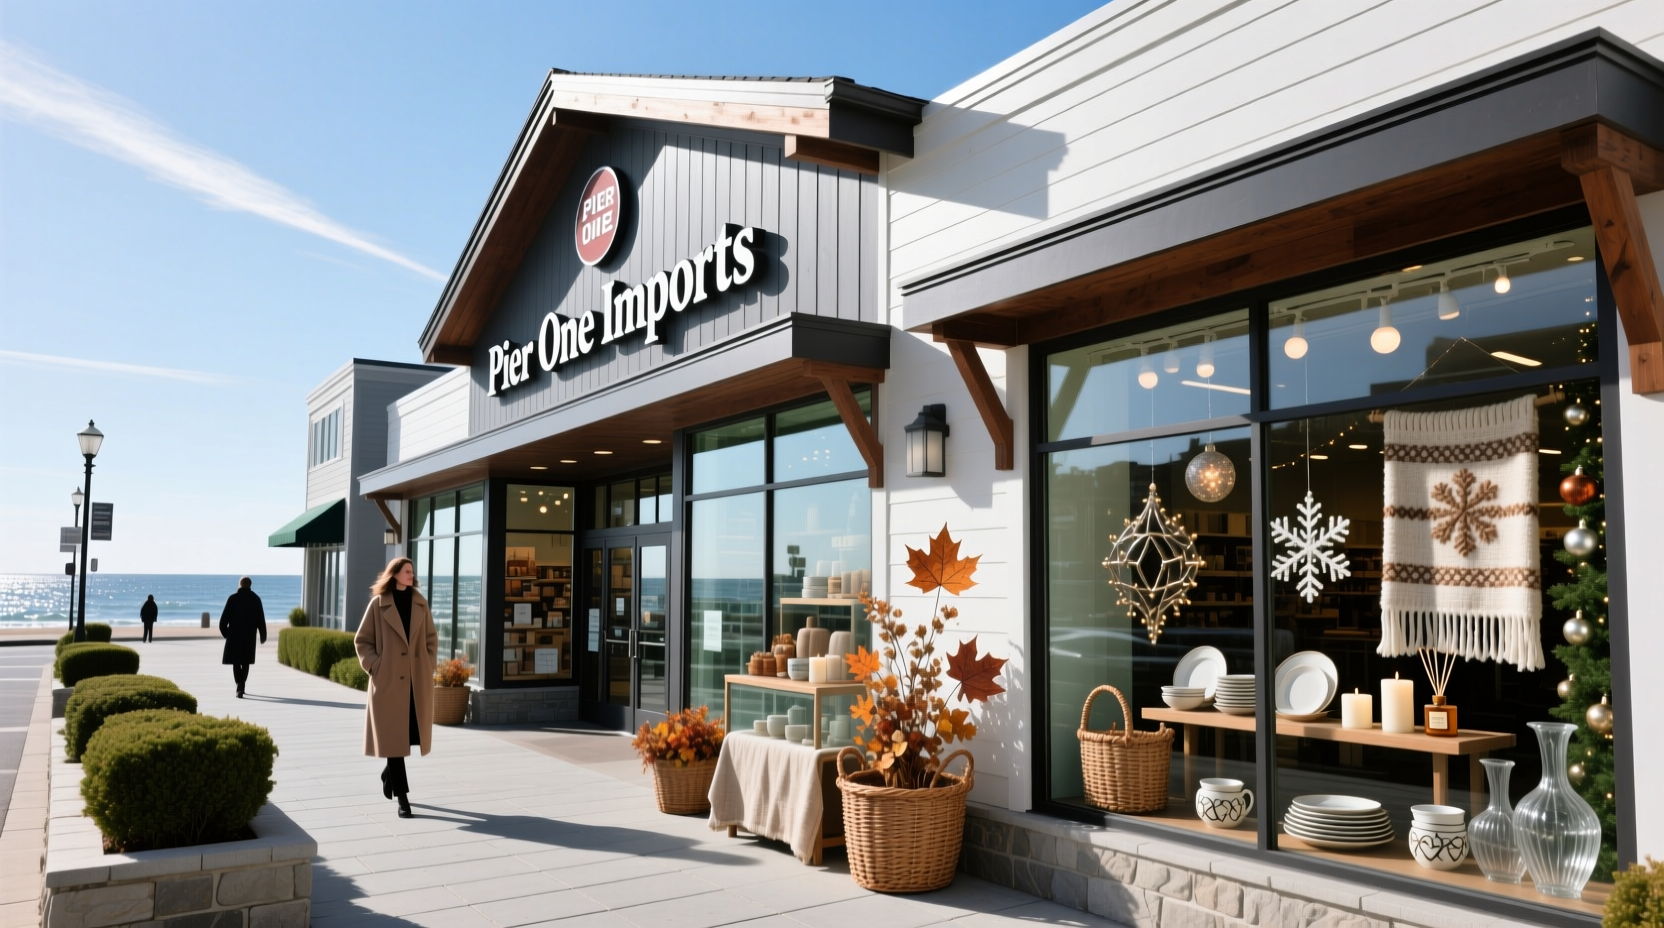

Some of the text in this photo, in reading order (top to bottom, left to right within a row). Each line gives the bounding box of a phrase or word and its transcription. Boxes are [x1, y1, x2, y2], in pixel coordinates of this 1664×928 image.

[582, 186, 614, 222] PIER
[487, 222, 755, 397] Pier One Imports
